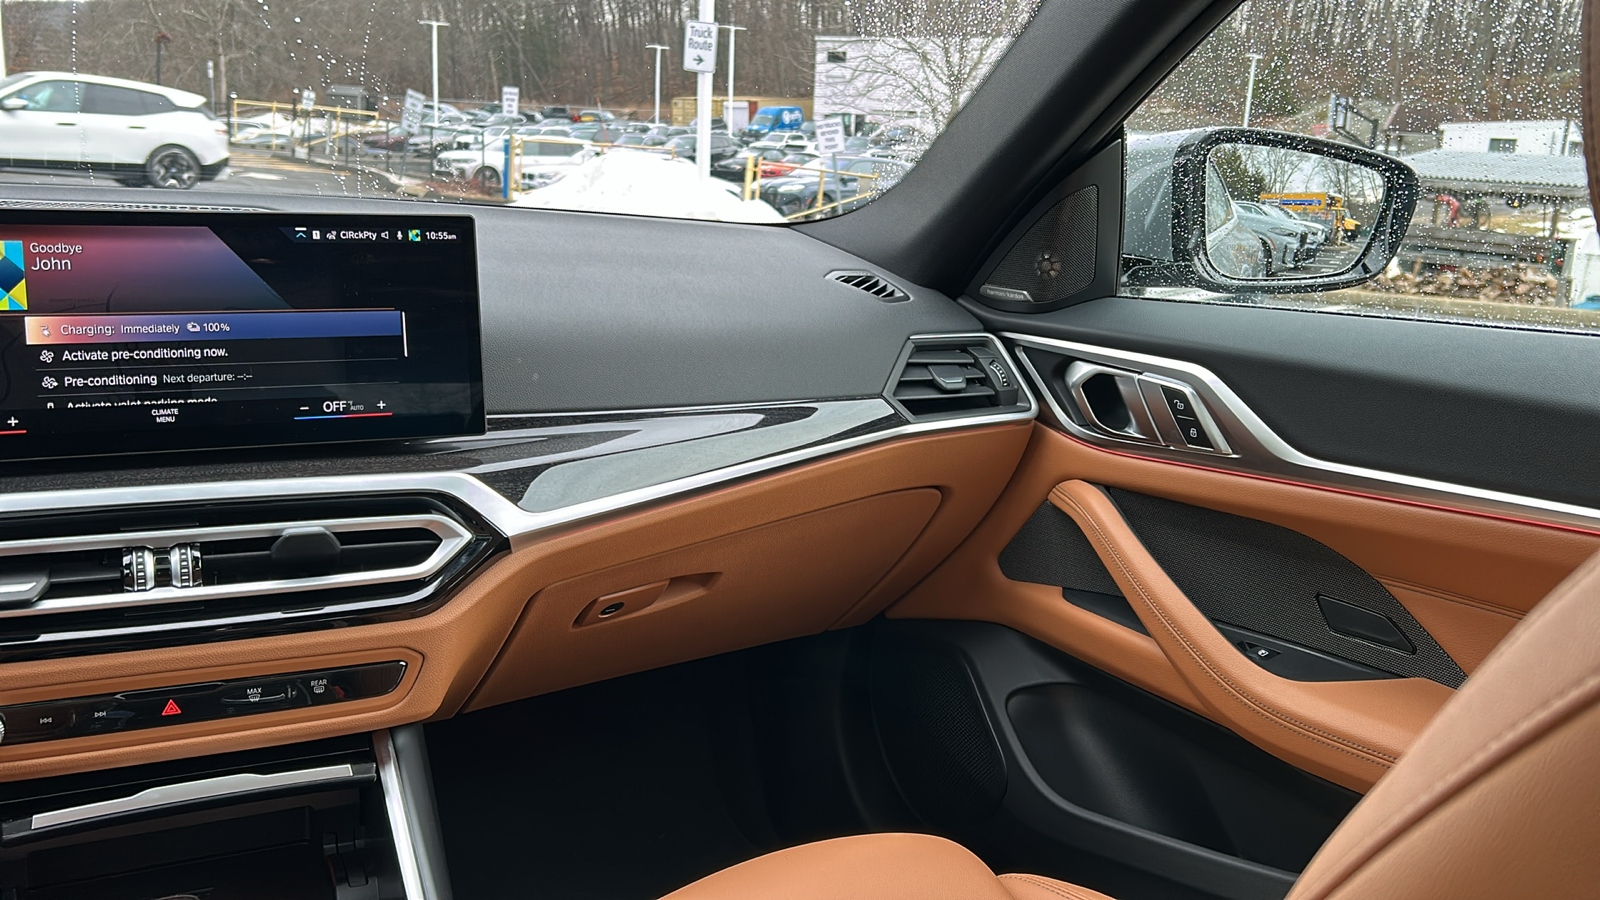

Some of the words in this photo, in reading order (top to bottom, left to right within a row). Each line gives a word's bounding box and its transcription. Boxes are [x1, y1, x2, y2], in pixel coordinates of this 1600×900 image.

[690, 26, 713, 38] Truck
[688, 38, 713, 51] Route
[29, 242, 83, 255] Goodbye
[31, 256, 71, 271] John
[60, 324, 115, 337] Charging:
[120, 323, 180, 335] Immediately
[202, 322, 231, 332] 100%
[62, 350, 109, 361] Activate
[111, 347, 201, 362] pre-conditioning
[203, 348, 229, 358] now.
[64, 374, 158, 387] Pre-conditioning
[162, 374, 186, 384] Next
[186, 372, 236, 384] departure:
[151, 408, 179, 416] CLIMATE
[322, 401, 347, 412] OFF
